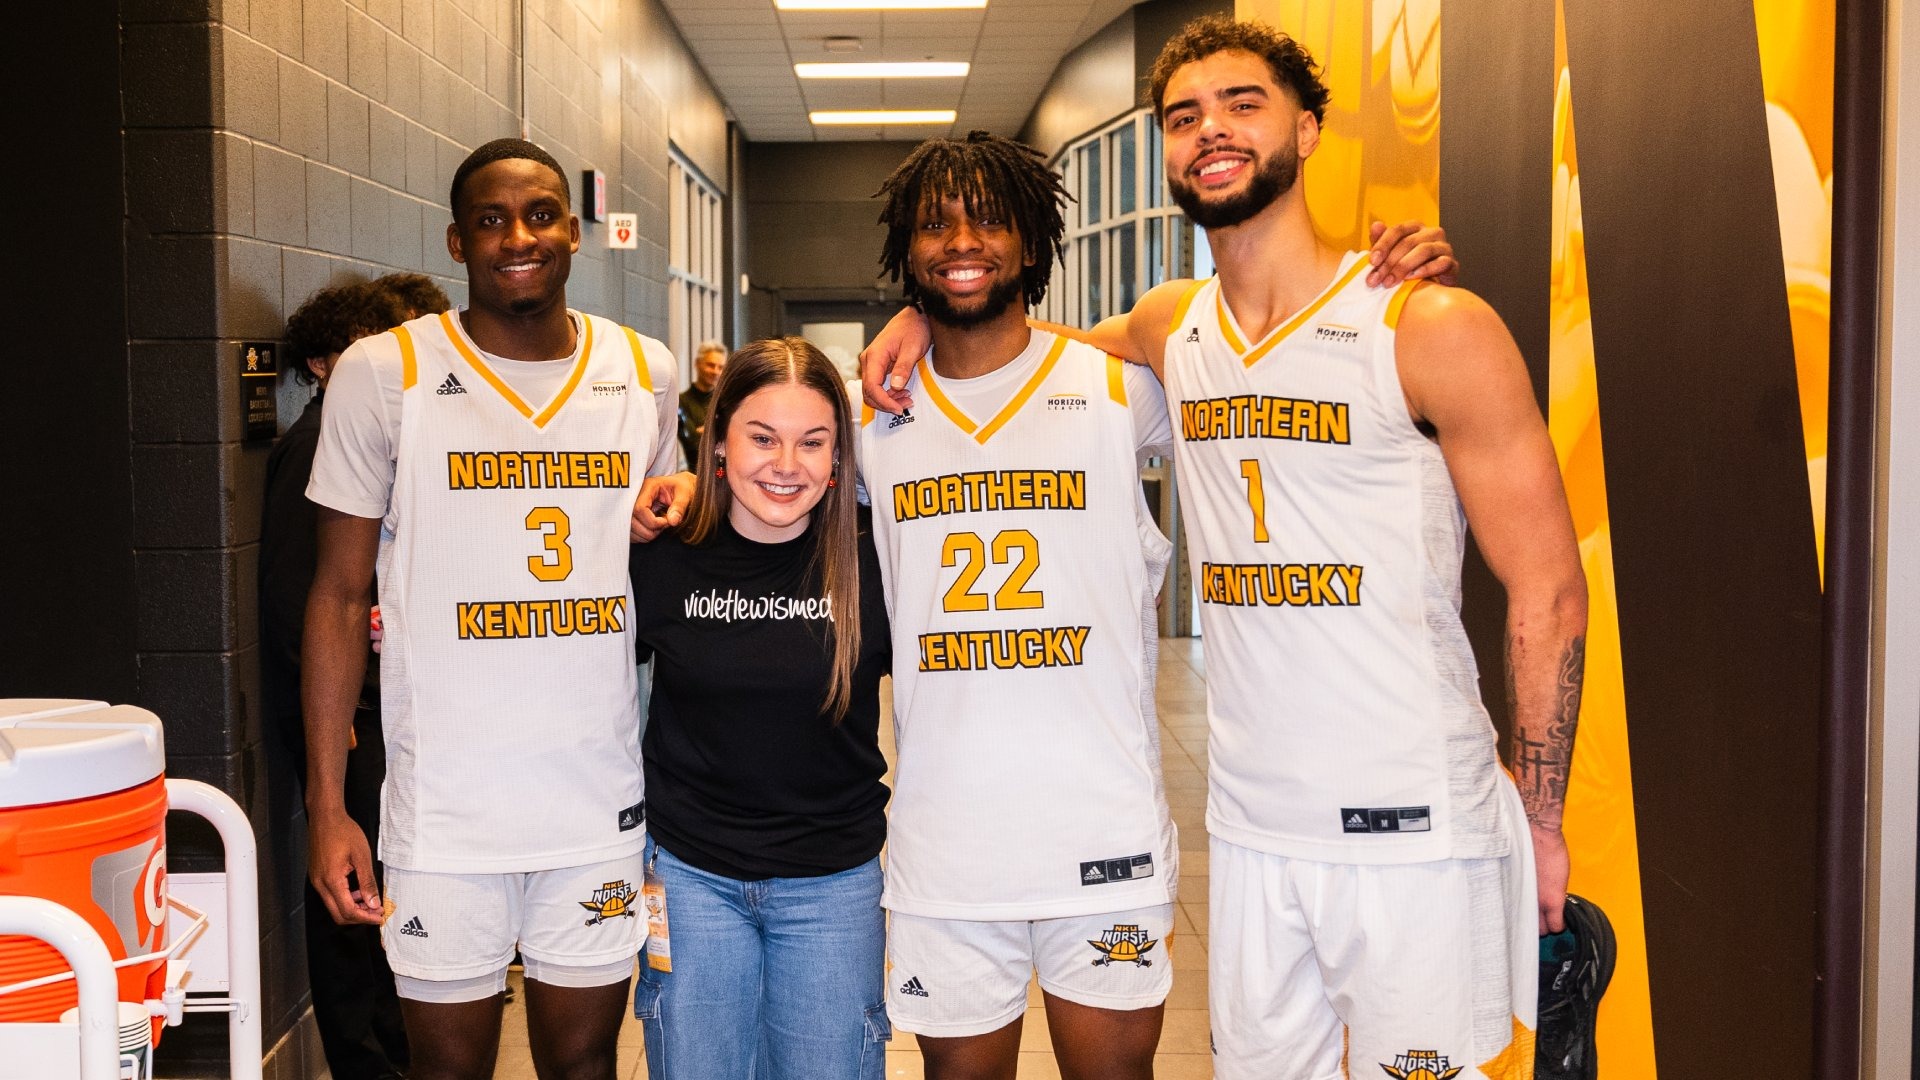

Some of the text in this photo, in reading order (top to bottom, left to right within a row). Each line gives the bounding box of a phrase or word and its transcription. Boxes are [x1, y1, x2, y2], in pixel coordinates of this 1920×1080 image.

[1317, 328, 1358, 338] HORIZON
[1181, 395, 1351, 445] NORTHERN
[447, 451, 630, 490] NORTHERN
[893, 470, 1086, 523] NORTHERN
[1240, 459, 1269, 543] 1
[525, 507, 573, 582] 3
[941, 529, 1044, 613] 22
[1380, 819, 1389, 828] M
[604, 880, 623, 890] NKU
[400, 928, 429, 938] adidas
[900, 987, 929, 997] adidas
[1409, 1050, 1437, 1058] NKU
